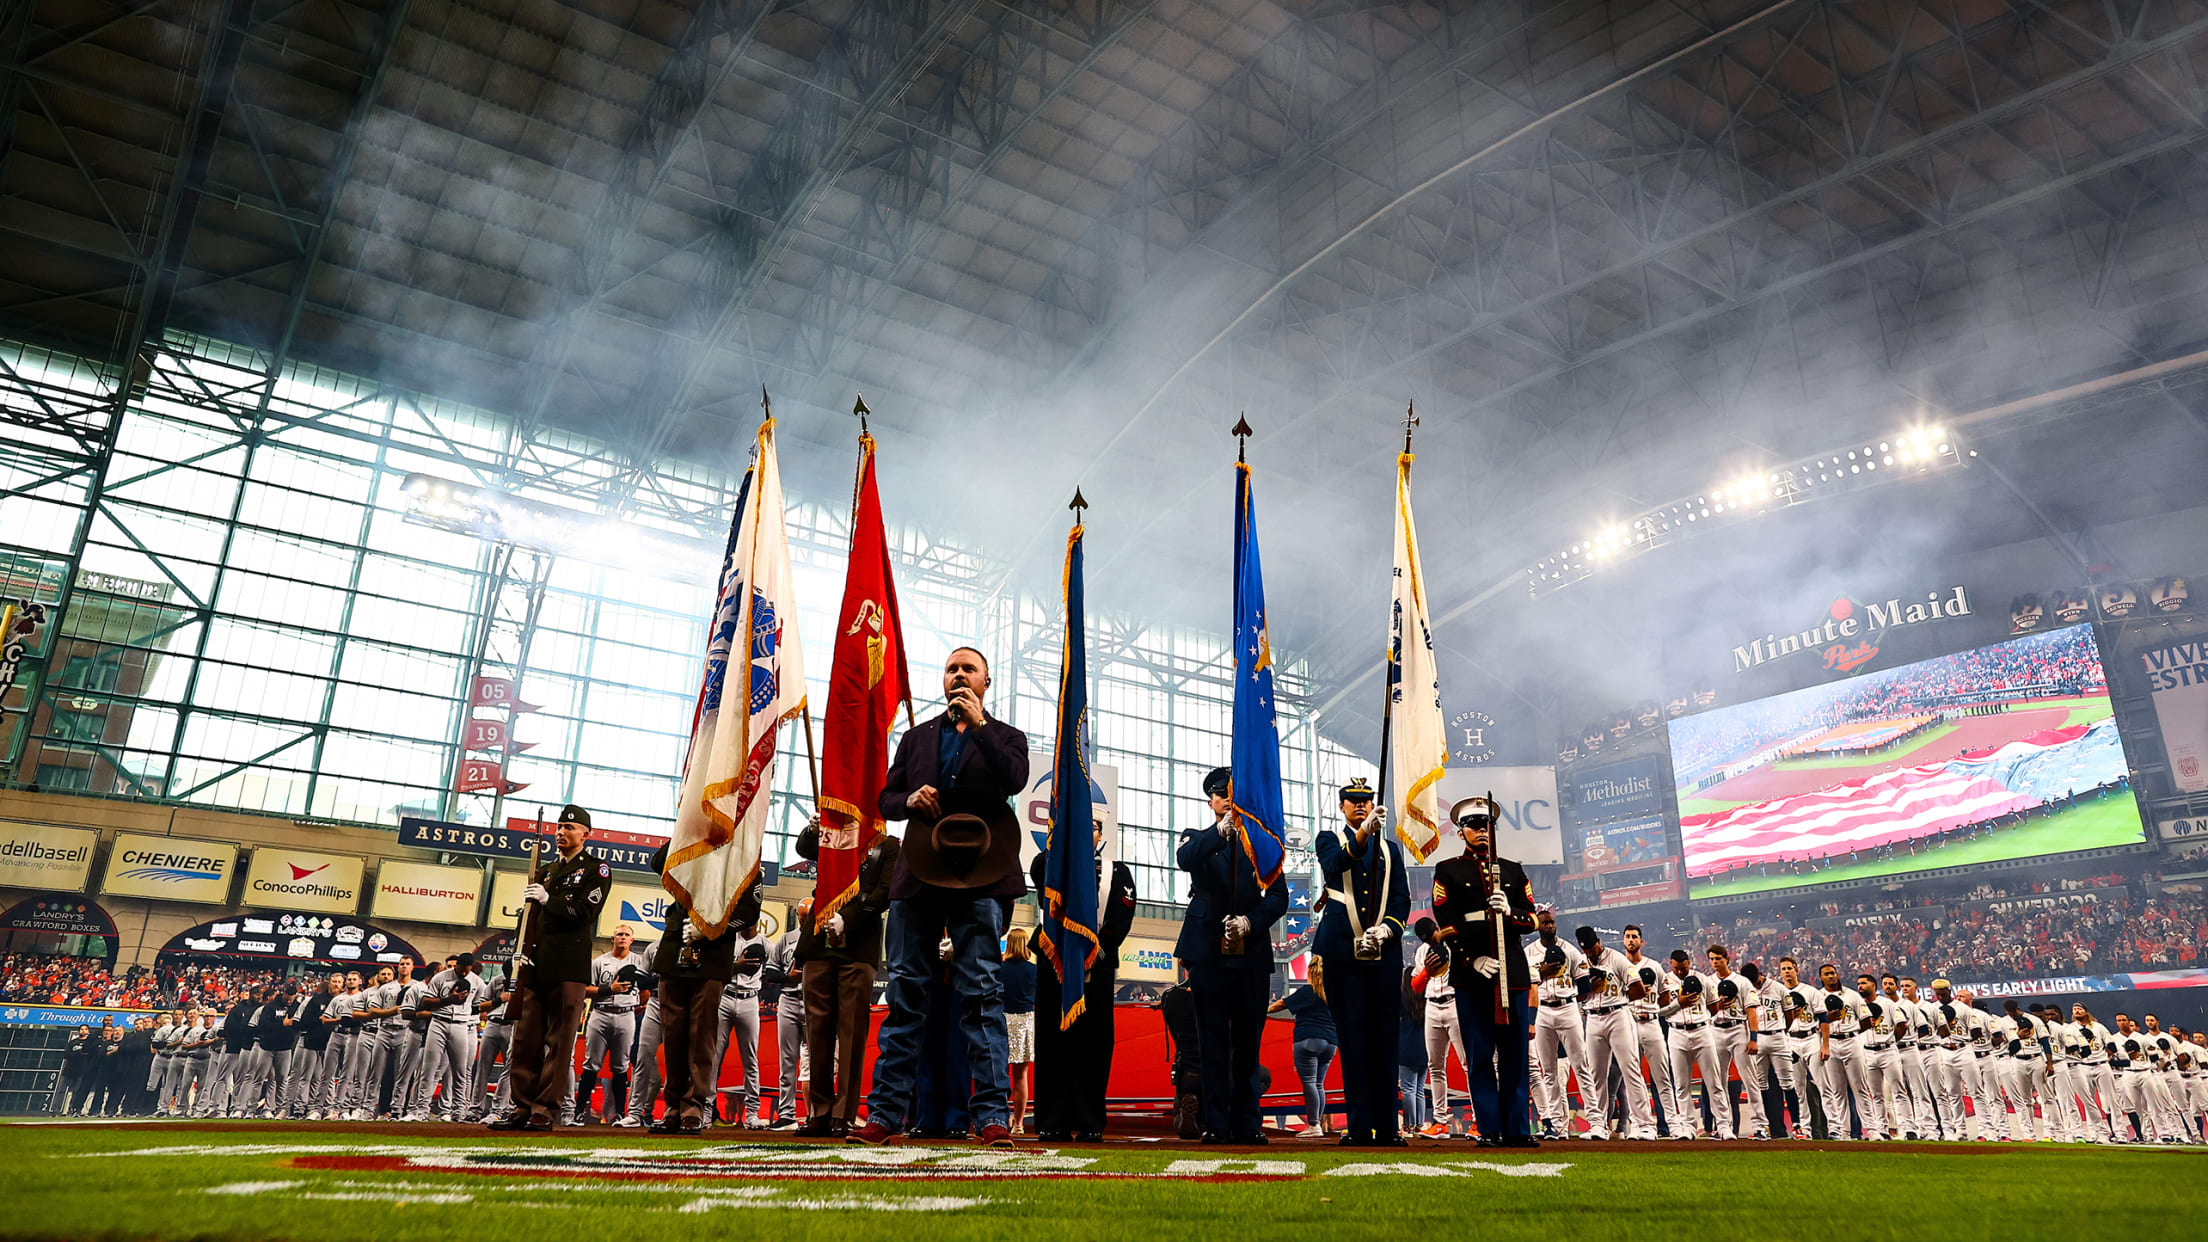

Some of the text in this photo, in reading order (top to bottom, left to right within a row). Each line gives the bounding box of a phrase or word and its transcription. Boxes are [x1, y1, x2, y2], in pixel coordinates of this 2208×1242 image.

[2106, 603, 2135, 614] BAGWELL
[1732, 585, 1972, 673] Minute Maid
[1822, 640, 1880, 672] Park
[482, 683, 505, 699] 05
[1451, 711, 1496, 728] HOUSTON
[476, 727, 498, 741] 19
[1464, 728, 1485, 746] H
[1455, 748, 1496, 763] ASTROS
[468, 767, 489, 782] 21
[1582, 776, 1652, 804] Methodist
[0, 840, 88, 862] dellbasell
[122, 850, 226, 872] CHENIERE
[253, 879, 352, 900] ConocoPhillips
[381, 885, 475, 901] HALLIBURTON
[33, 911, 85, 921] LANDRY'S
[12, 919, 101, 933] CRAWFORD BOXES
[1139, 950, 1173, 970] LNG
[1556, 975, 1572, 989] 44
[1992, 979, 2038, 996] EARLY
[40, 1012, 86, 1024] Through
[87, 1014, 98, 1023] it
[1766, 1010, 1779, 1022] 14
